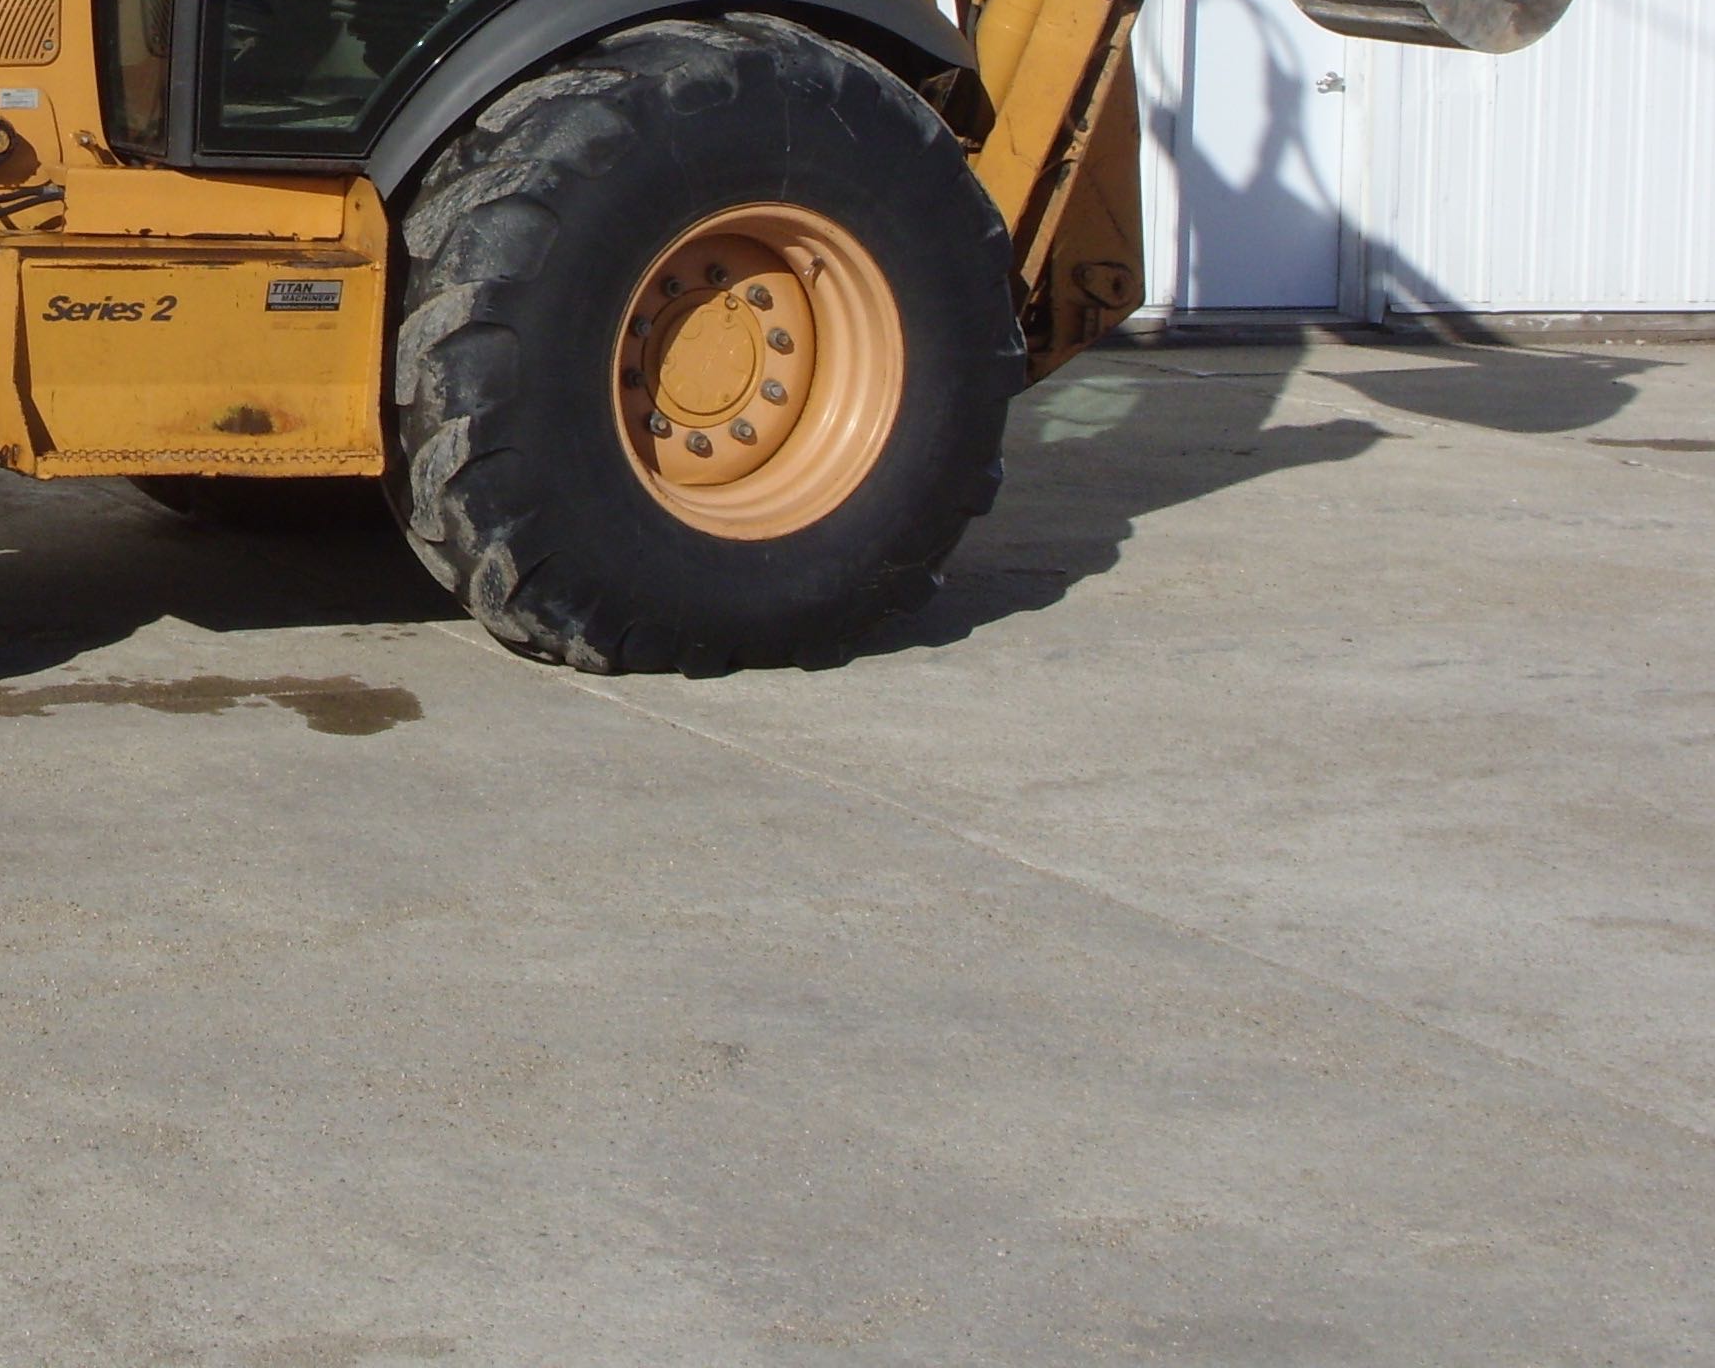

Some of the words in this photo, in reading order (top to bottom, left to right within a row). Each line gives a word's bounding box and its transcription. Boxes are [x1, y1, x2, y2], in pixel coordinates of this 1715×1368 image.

[272, 283, 314, 294] TITAN
[42, 295, 145, 322] Series
[150, 295, 178, 322] 2
